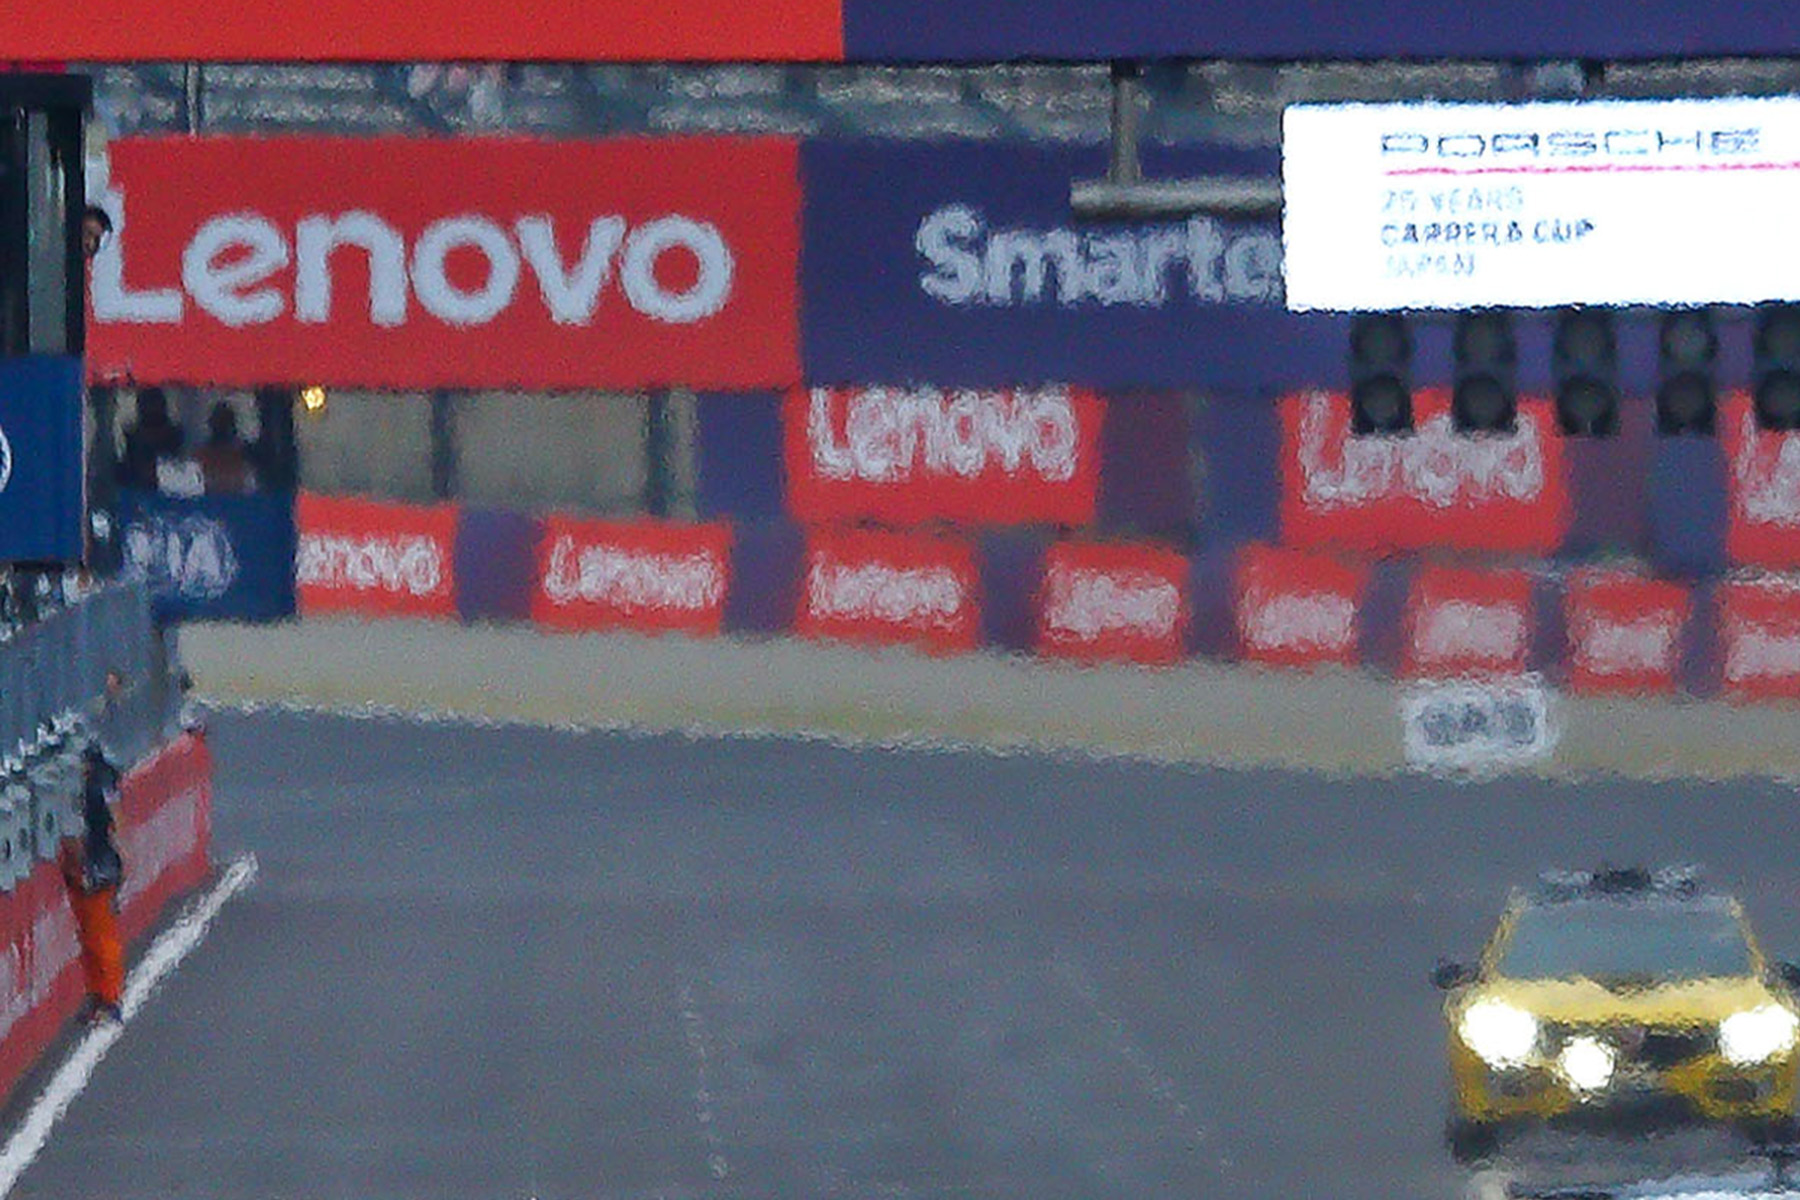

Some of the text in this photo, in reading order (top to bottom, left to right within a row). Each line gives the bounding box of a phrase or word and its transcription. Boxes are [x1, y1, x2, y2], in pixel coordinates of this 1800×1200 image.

[1381, 127, 1761, 157] PORSCHE
[90, 192, 735, 326] Lenovo
[915, 203, 1284, 304] Smarte
[1532, 217, 1597, 245] CUP
